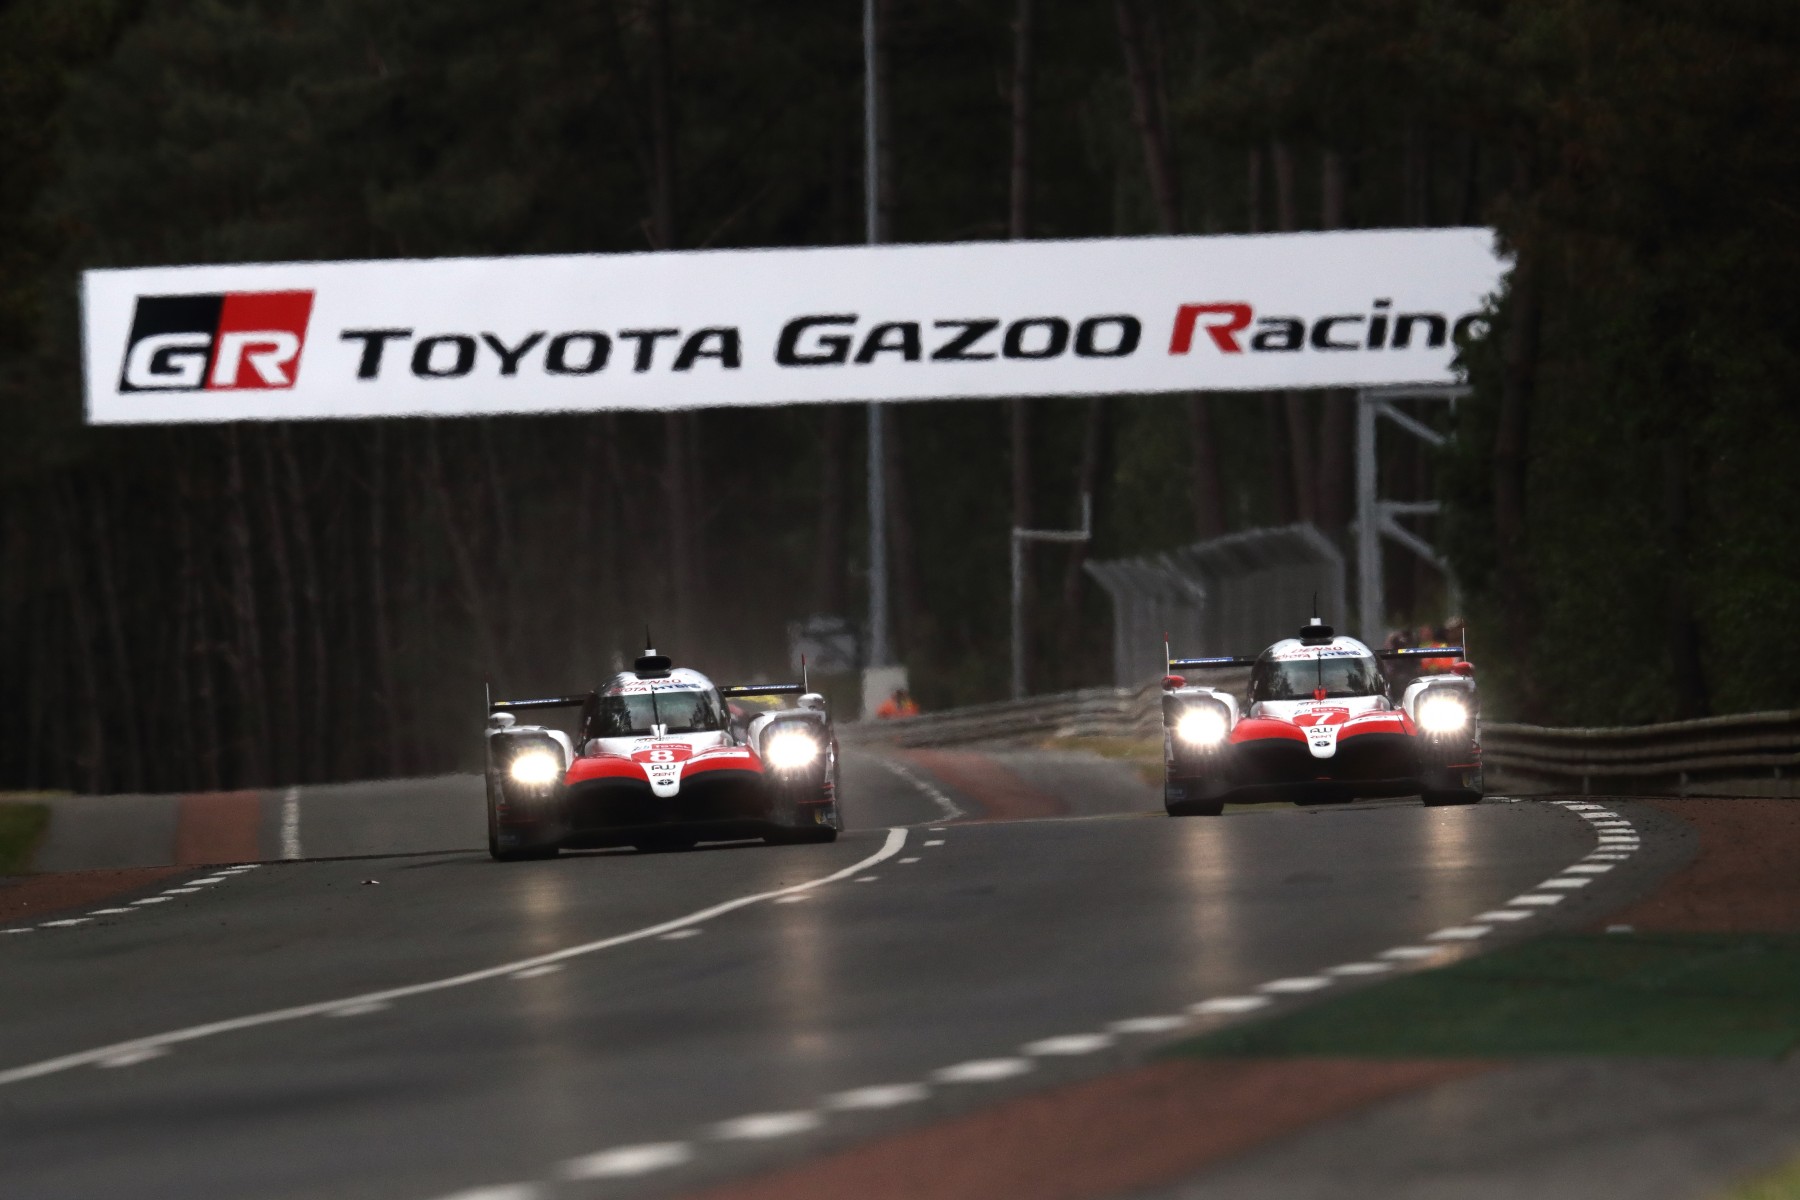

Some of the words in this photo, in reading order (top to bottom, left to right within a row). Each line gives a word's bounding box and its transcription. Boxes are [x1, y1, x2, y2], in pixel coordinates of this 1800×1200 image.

[123, 330, 303, 390] GR
[340, 327, 741, 379] TOYOTA
[775, 313, 1142, 367] GAZOO
[1311, 712, 1334, 725] 7
[650, 750, 675, 762] 8
